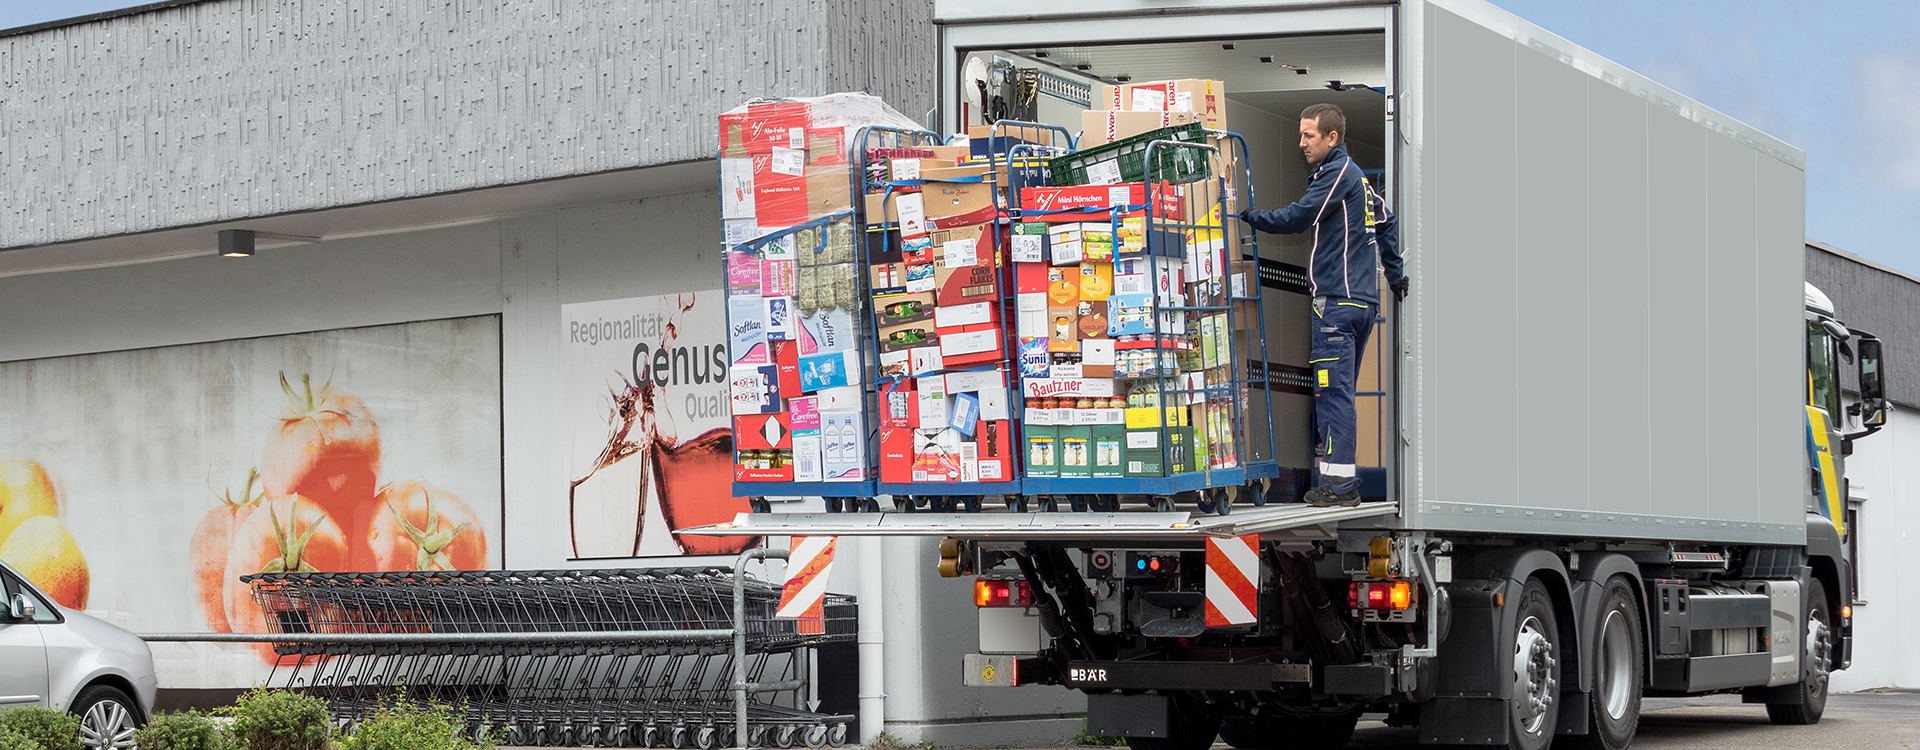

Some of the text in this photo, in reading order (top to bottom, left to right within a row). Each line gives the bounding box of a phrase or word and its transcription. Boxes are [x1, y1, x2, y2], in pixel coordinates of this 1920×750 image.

[764, 126, 786, 134] Alu-Folie
[1057, 194, 1103, 204] Mini Hörnchen
[730, 266, 759, 276] Carefree
[971, 266, 991, 276] CORN
[969, 274, 994, 285] FLAKES
[570, 313, 664, 346] Regionalität
[733, 319, 762, 338] Softlan
[818, 311, 835, 348] Softlan
[1022, 352, 1047, 365] Sunil
[685, 389, 731, 422] Quali
[791, 411, 819, 421] Carefree
[1078, 668, 1108, 682] BÄR
